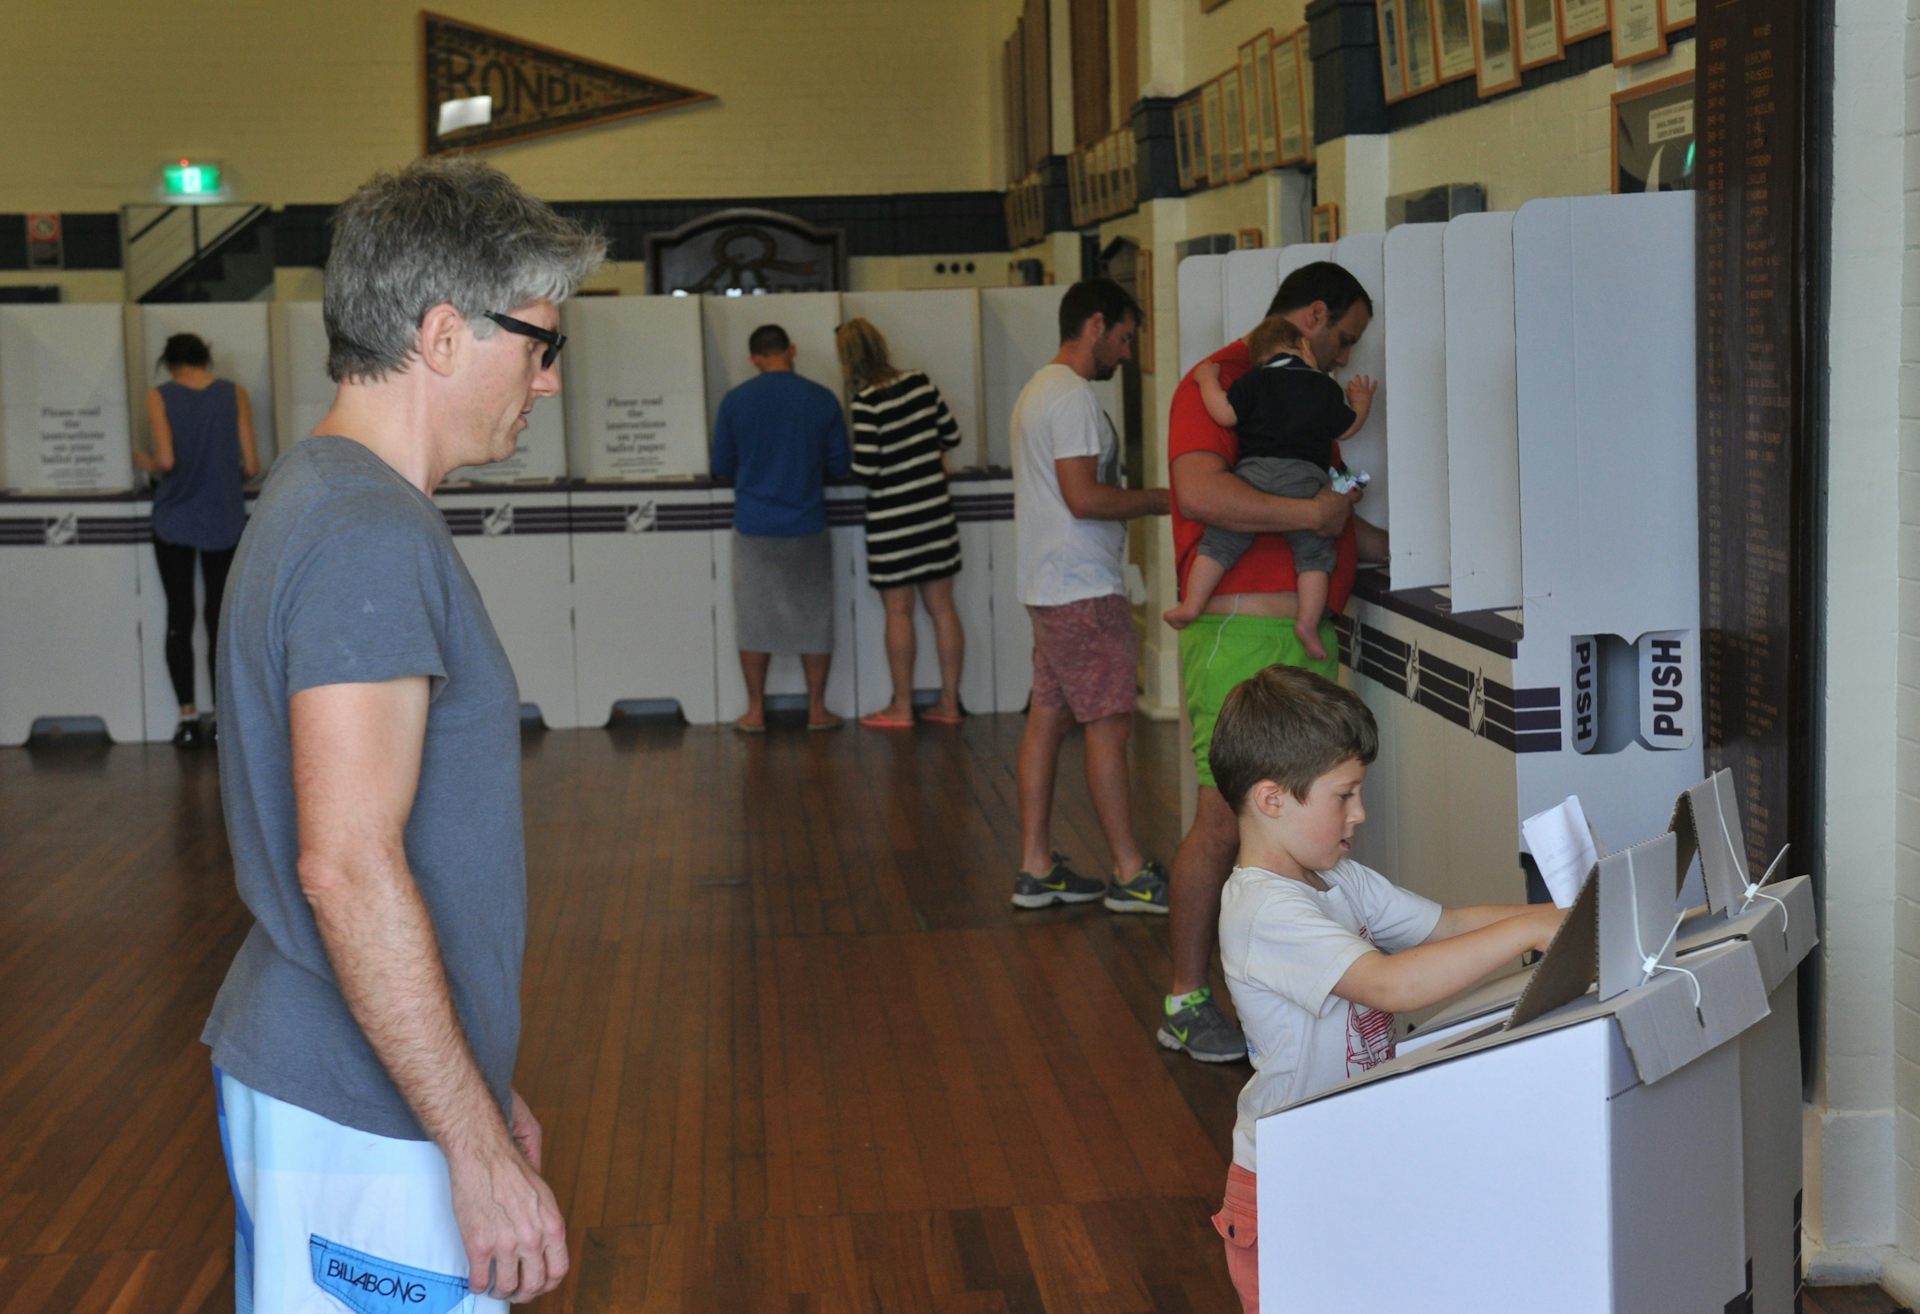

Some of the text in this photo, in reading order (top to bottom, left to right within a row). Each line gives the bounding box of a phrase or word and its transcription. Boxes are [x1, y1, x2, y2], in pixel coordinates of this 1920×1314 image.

[1576, 642, 1592, 741] PUSH
[1651, 640, 1684, 737] PUSH
[327, 1259, 427, 1305] BILLABONG
